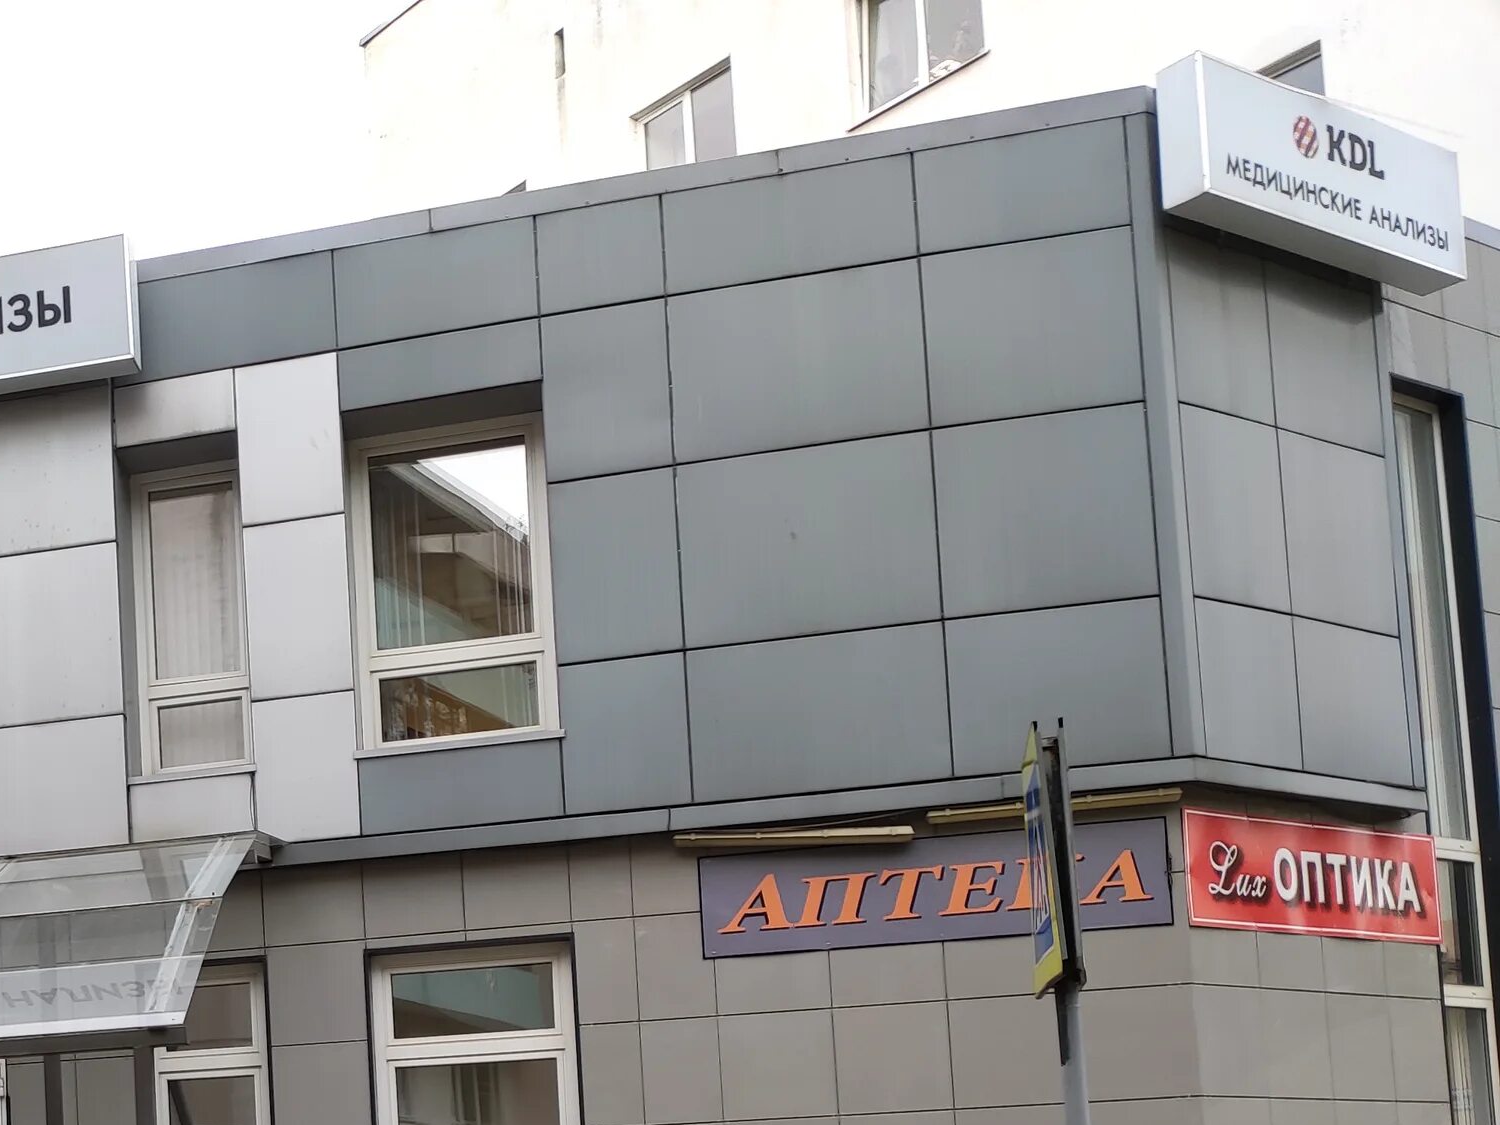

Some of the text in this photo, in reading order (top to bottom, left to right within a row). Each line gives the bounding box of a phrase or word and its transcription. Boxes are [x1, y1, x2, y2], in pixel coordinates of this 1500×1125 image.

[1326, 124, 1385, 180] KDL
[1225, 152, 1449, 251] МЕДИЦИНСКИЕ АНАЛИЗЫ
[1208, 840, 1422, 913] Lux ОПТИКА
